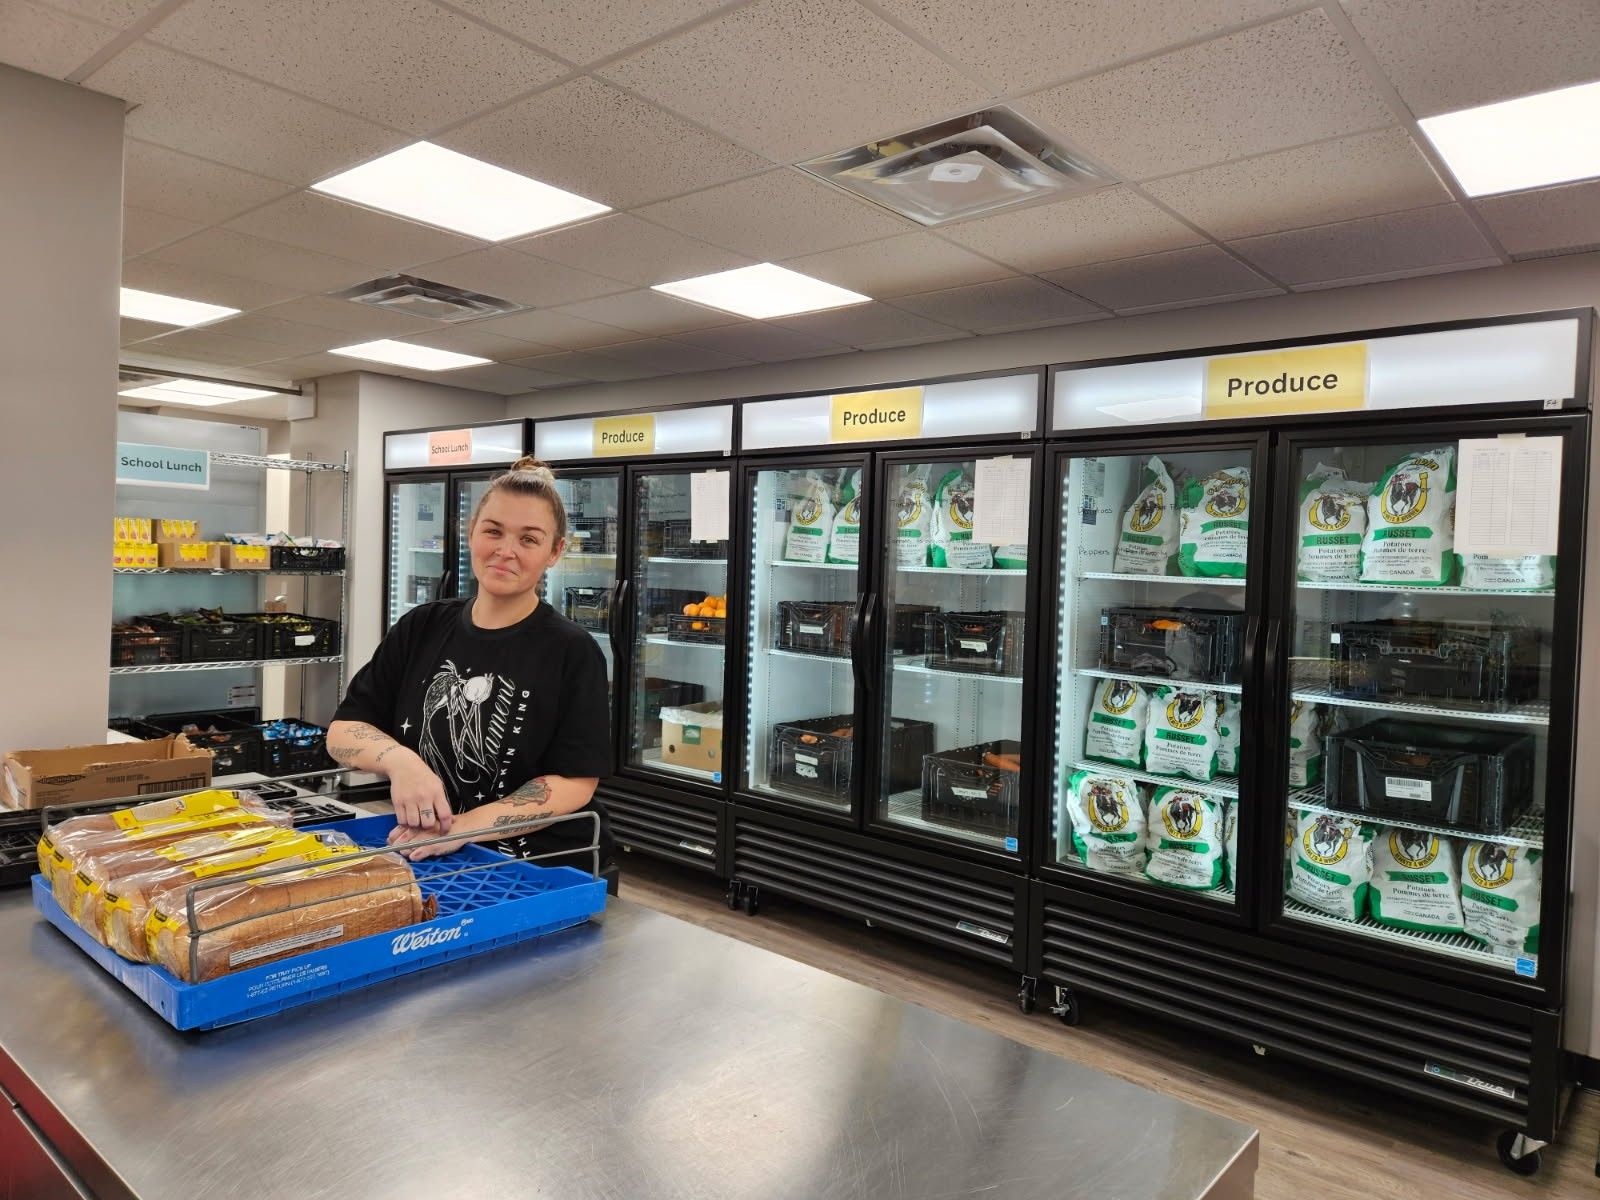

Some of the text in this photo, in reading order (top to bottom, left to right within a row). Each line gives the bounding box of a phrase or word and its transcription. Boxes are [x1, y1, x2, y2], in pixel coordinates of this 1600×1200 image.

[1227, 372, 1338, 398] Produce
[843, 408, 906, 426] Produce
[601, 429, 645, 444] Produce
[431, 442, 469, 454] School Lunch
[121, 456, 202, 472] School Lunch
[1317, 535, 1350, 545] RUSSET
[513, 690, 531, 735] KING
[1166, 731, 1195, 744] RUSSET
[1306, 863, 1337, 881] RUSSET
[1392, 887, 1421, 897] Pommes
[1471, 890, 1502, 907] RUSSET
[1414, 911, 1440, 920] CANADA
[391, 926, 462, 956] Weston
[277, 969, 290, 978] TRAY
[291, 966, 304, 974] PICK
